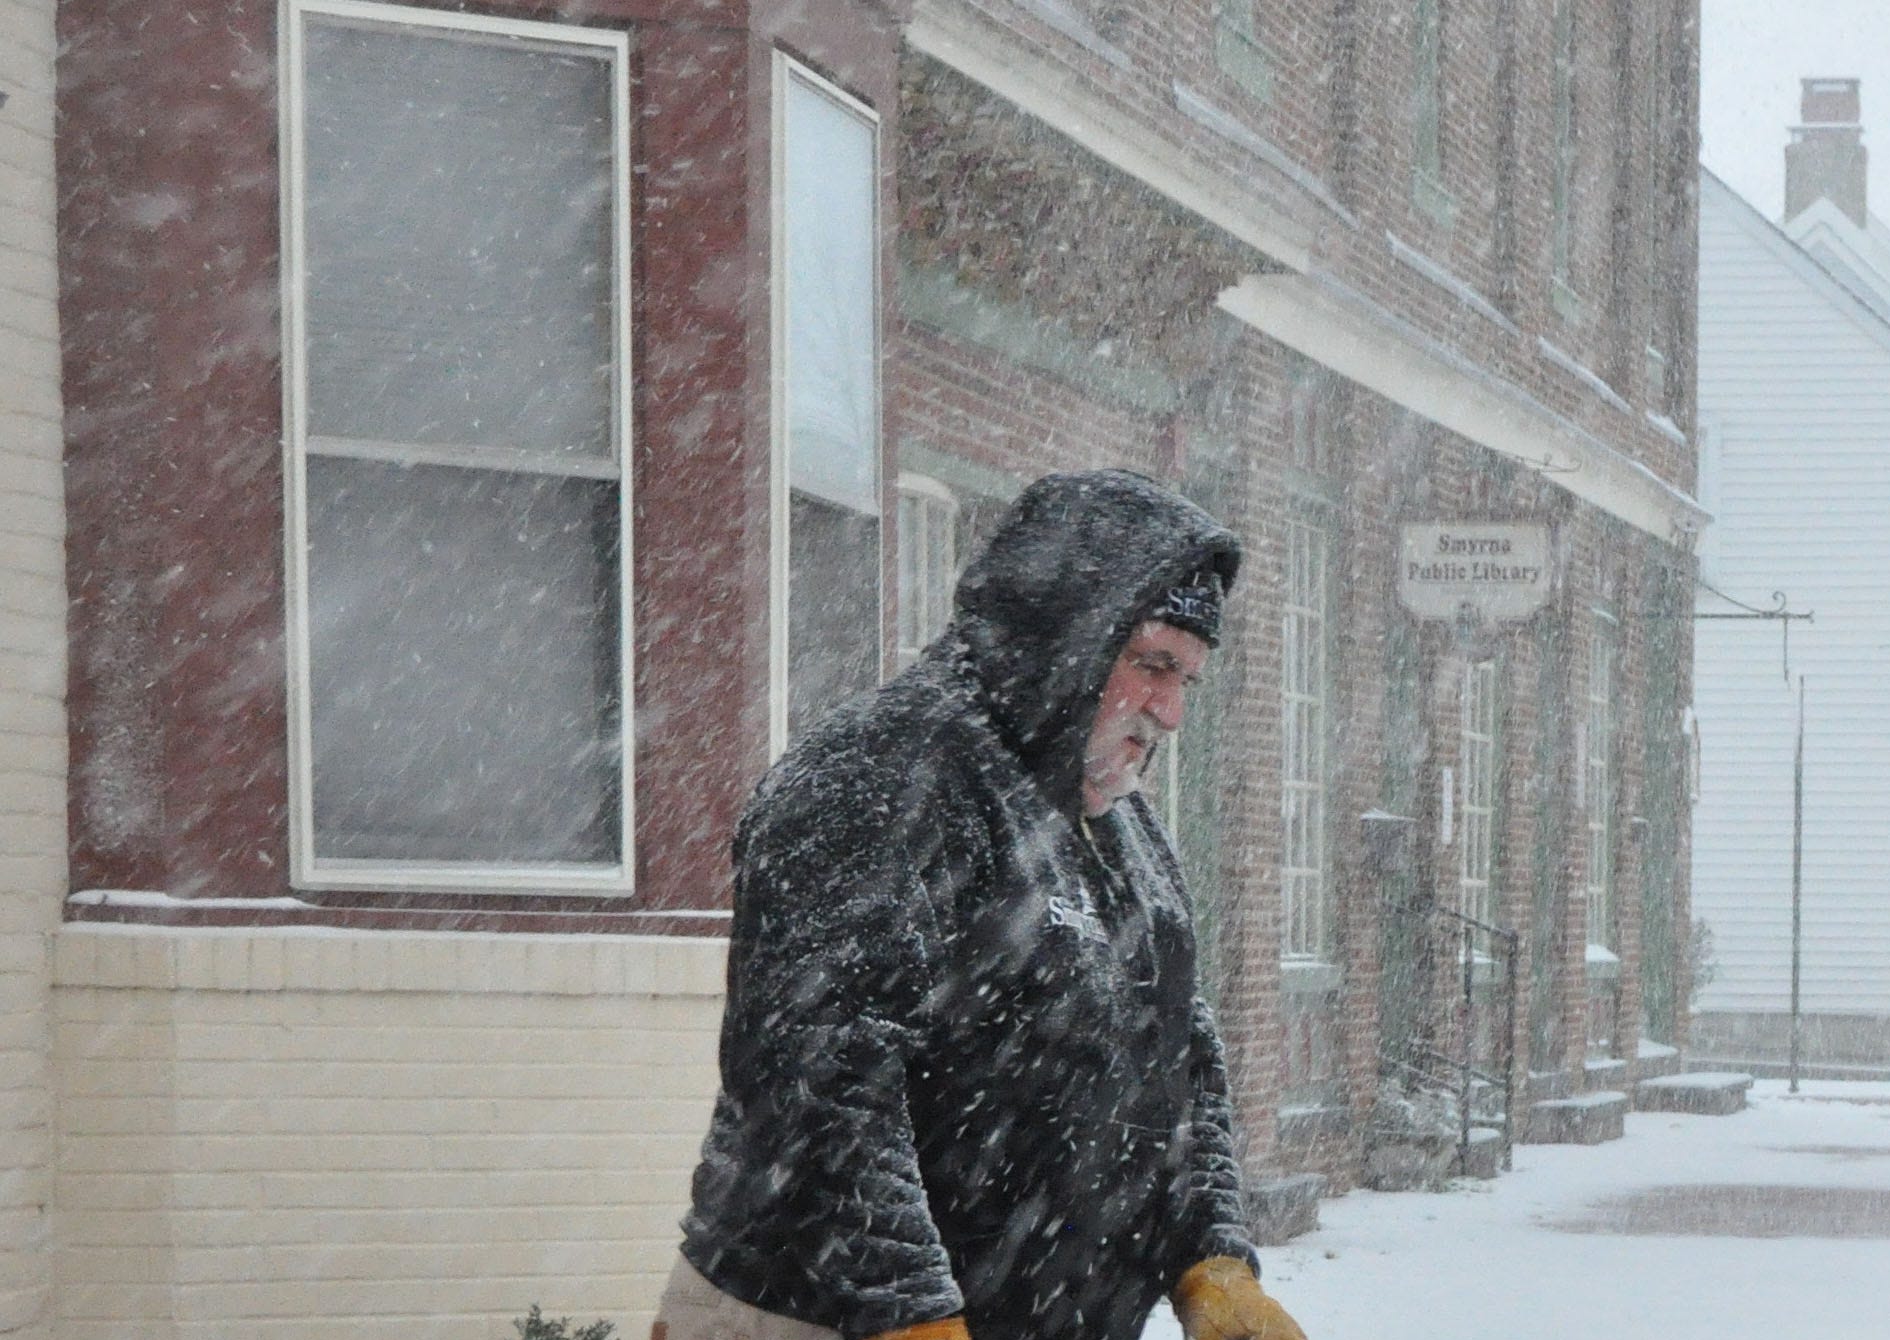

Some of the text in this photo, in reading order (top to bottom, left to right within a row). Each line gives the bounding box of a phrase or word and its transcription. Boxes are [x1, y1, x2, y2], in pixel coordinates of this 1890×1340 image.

[1439, 534, 1511, 555] Smyrna
[1408, 562, 1540, 584] Public Library
